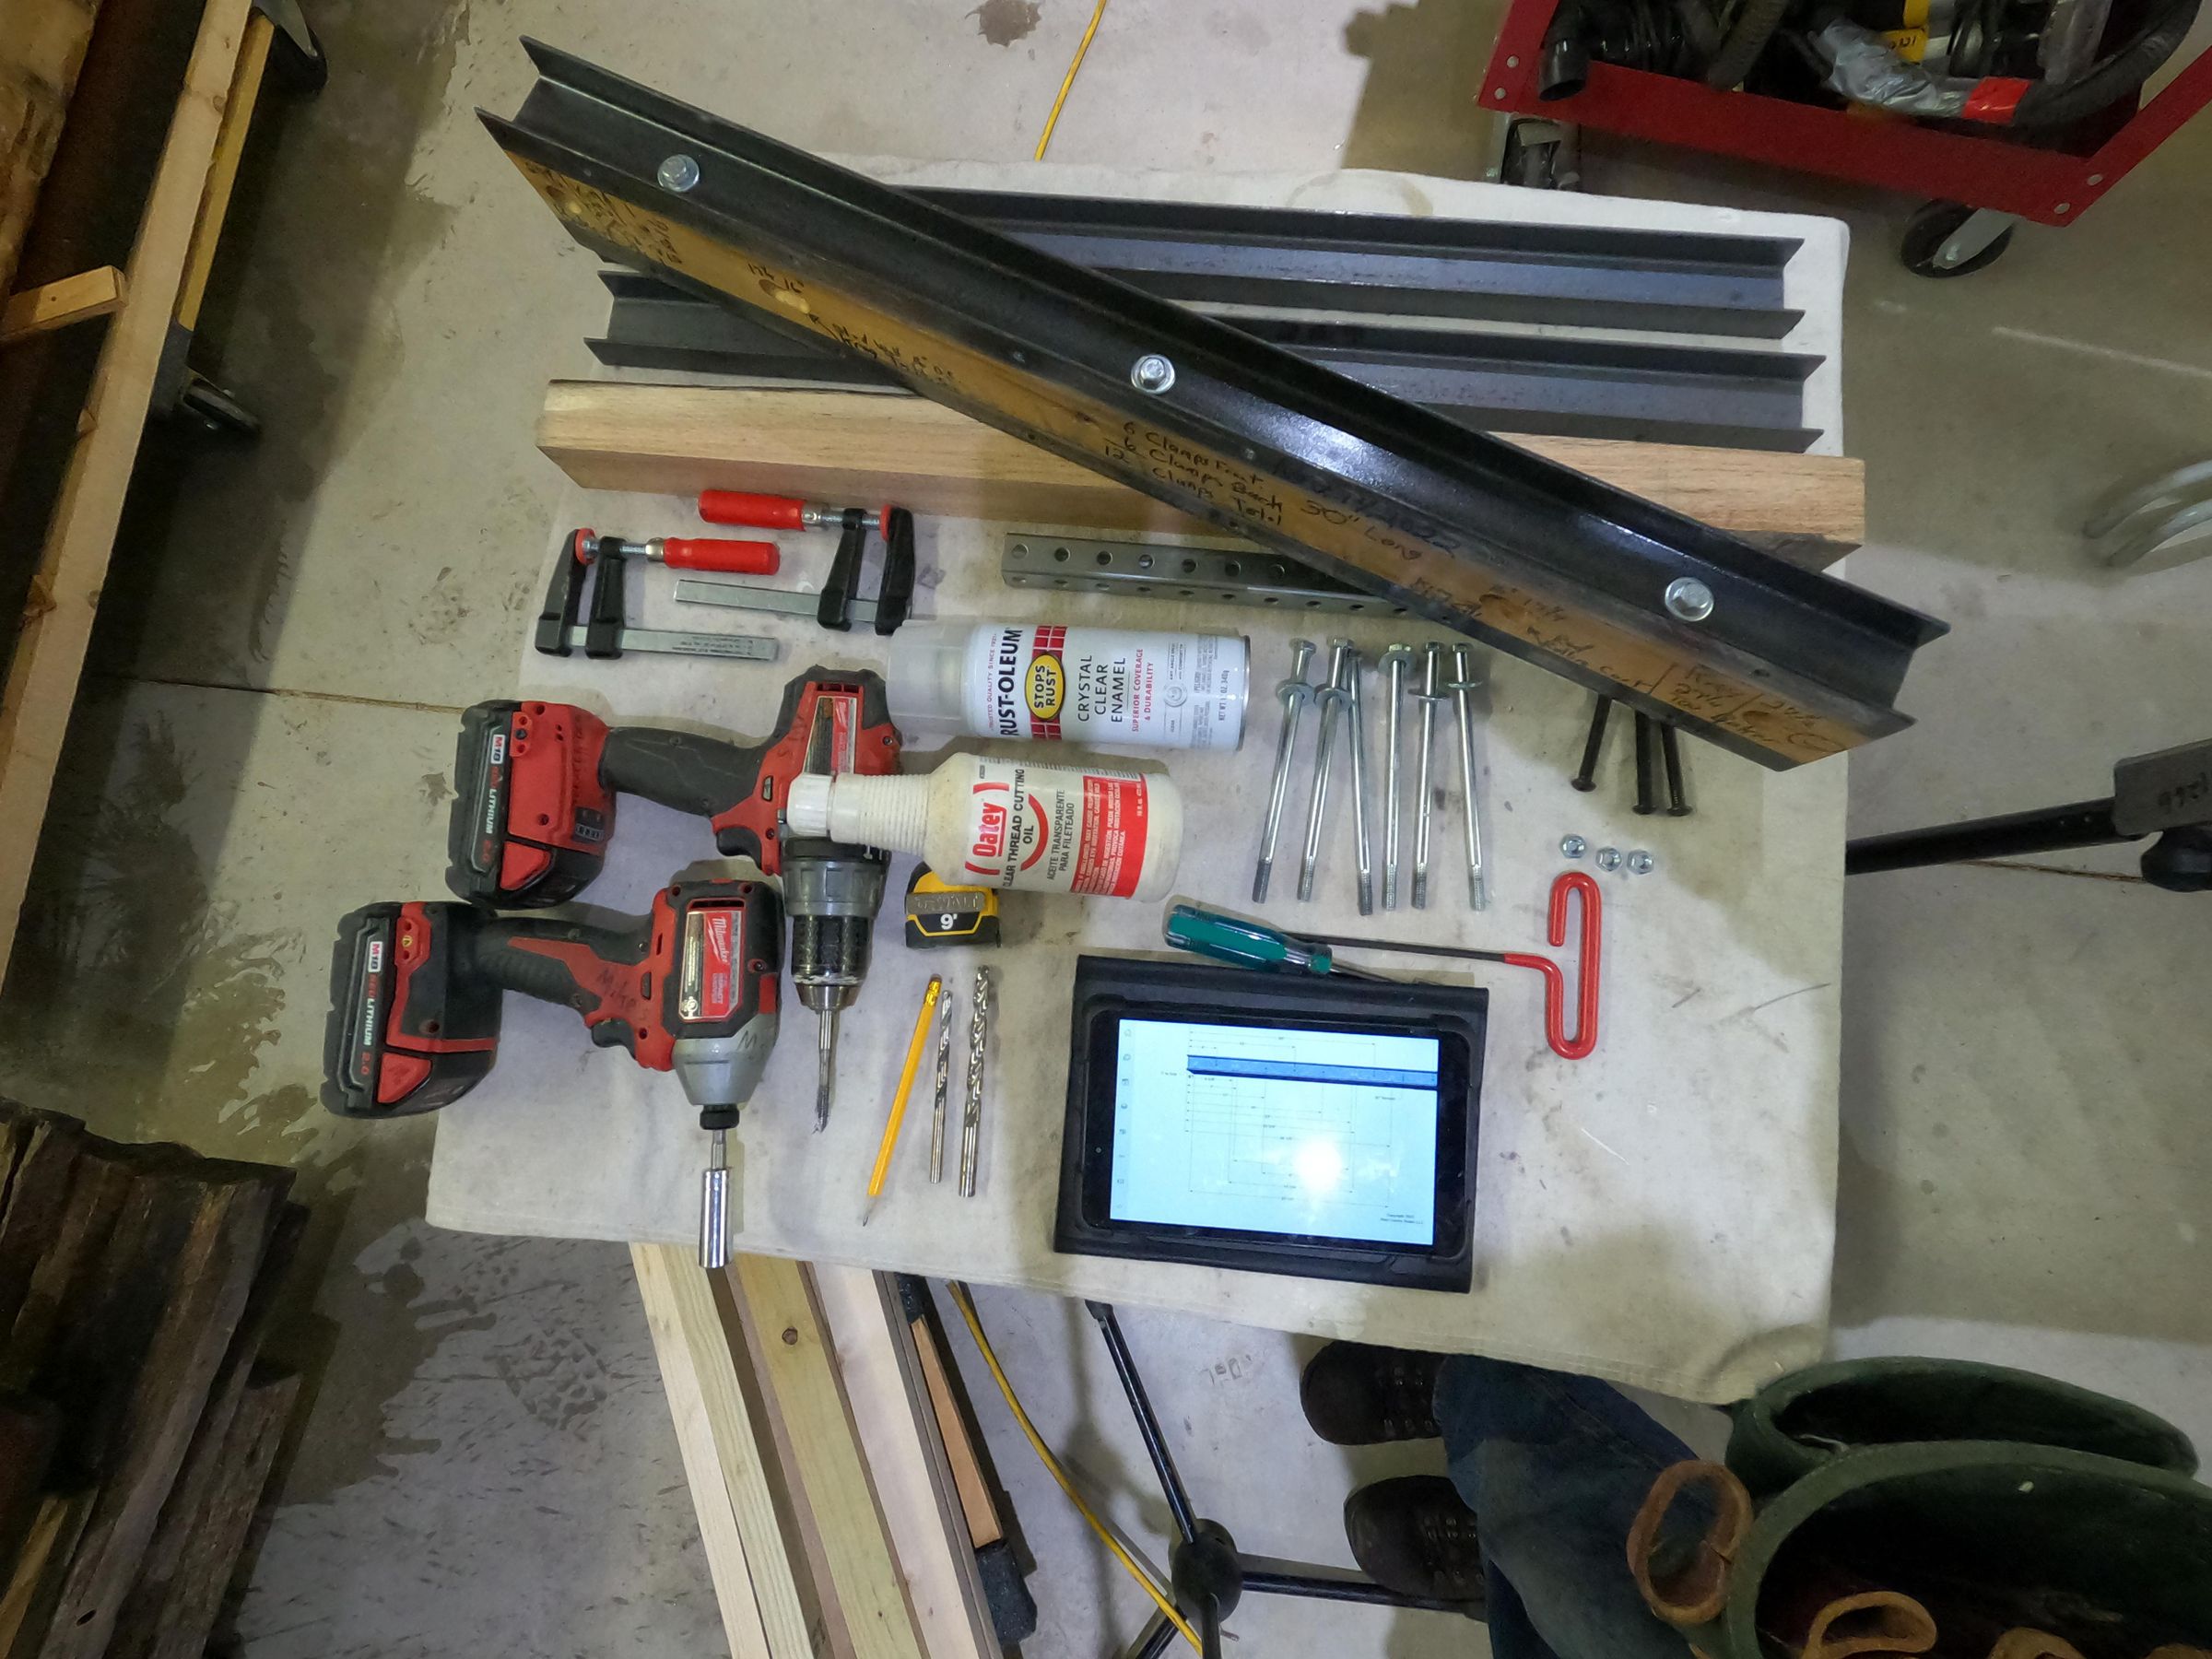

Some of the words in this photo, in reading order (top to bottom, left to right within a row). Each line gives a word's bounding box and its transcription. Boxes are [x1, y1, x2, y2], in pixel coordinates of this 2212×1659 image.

[1105, 446, 1129, 464] 12
[1124, 422, 1135, 435] 6
[1146, 431, 1208, 466] Clamps
[1124, 437, 1136, 452] 6
[1364, 526, 1421, 560] Long
[998, 629, 1023, 735] RUST-OLEUM
[1034, 665, 1045, 708] STOPS
[1046, 669, 1056, 706] RUST
[1077, 655, 1092, 722] CRYSTAL
[1095, 665, 1108, 714] CLEAR
[1112, 658, 1125, 723] ENAMEL
[1134, 649, 1143, 690] COVERAGE
[1144, 662, 1153, 712] DURABILITY
[1132, 694, 1140, 732] SUPERIOR
[492, 736, 502, 761] M18
[1014, 769, 1025, 811] CUTTING
[972, 802, 1006, 856] Oatey
[1007, 815, 1022, 862] THREAD
[1023, 825, 1034, 844] OIL
[1051, 789, 1065, 853] TRANSPARENTE
[1059, 852, 1069, 871] PARA
[1064, 803, 1075, 849] FILETEADO
[1003, 865, 1016, 887] CLEAR
[1047, 857, 1059, 880] ACEITE
[371, 943, 380, 970] M18
